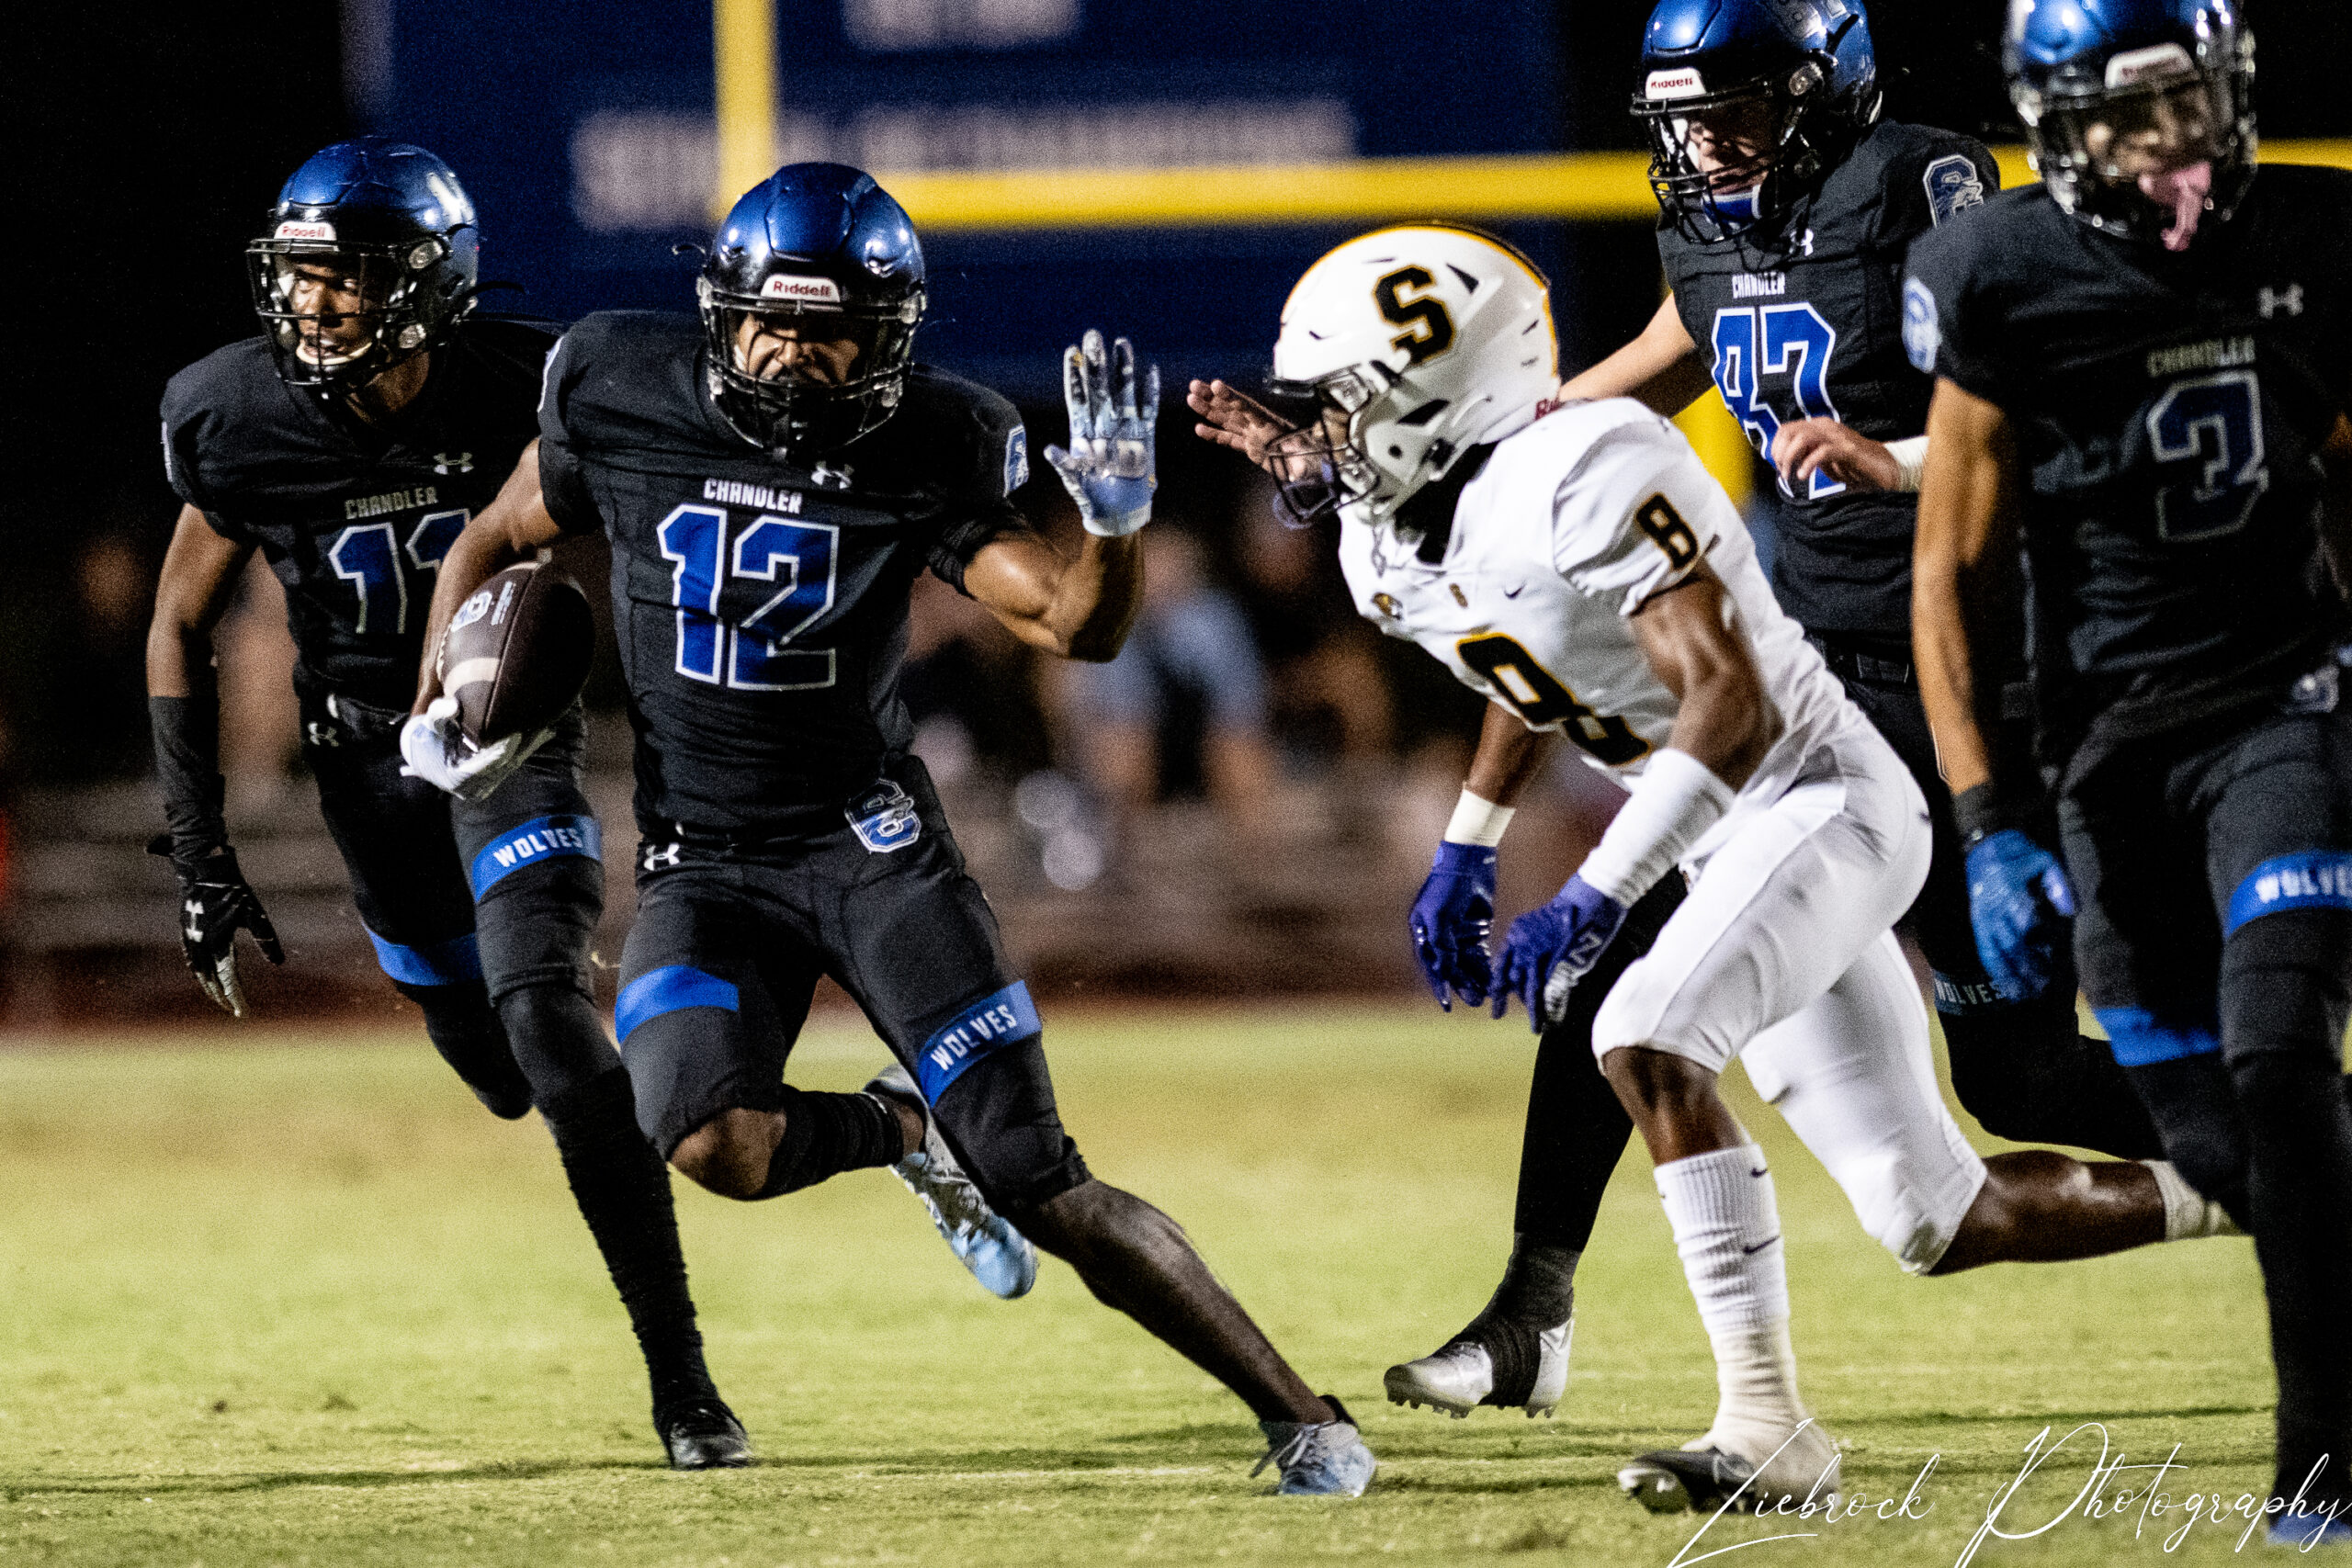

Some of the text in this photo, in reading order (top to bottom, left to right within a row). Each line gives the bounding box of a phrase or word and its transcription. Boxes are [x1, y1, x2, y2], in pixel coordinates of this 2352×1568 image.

[773, 280, 831, 297] Riddell
[1732, 271, 1785, 299] CHANDLER
[1372, 265, 1456, 363] S
[2146, 369, 2269, 544] 3
[345, 486, 438, 520] CHANDLER
[704, 478, 803, 514] CHANDLER
[1634, 491, 1700, 573] 8
[656, 503, 840, 691] 12
[1456, 631, 1653, 767] 8
[492, 828, 584, 867] WOLVES
[2256, 864, 2352, 904] WOLVE
[930, 1004, 1017, 1071] WOLVES
